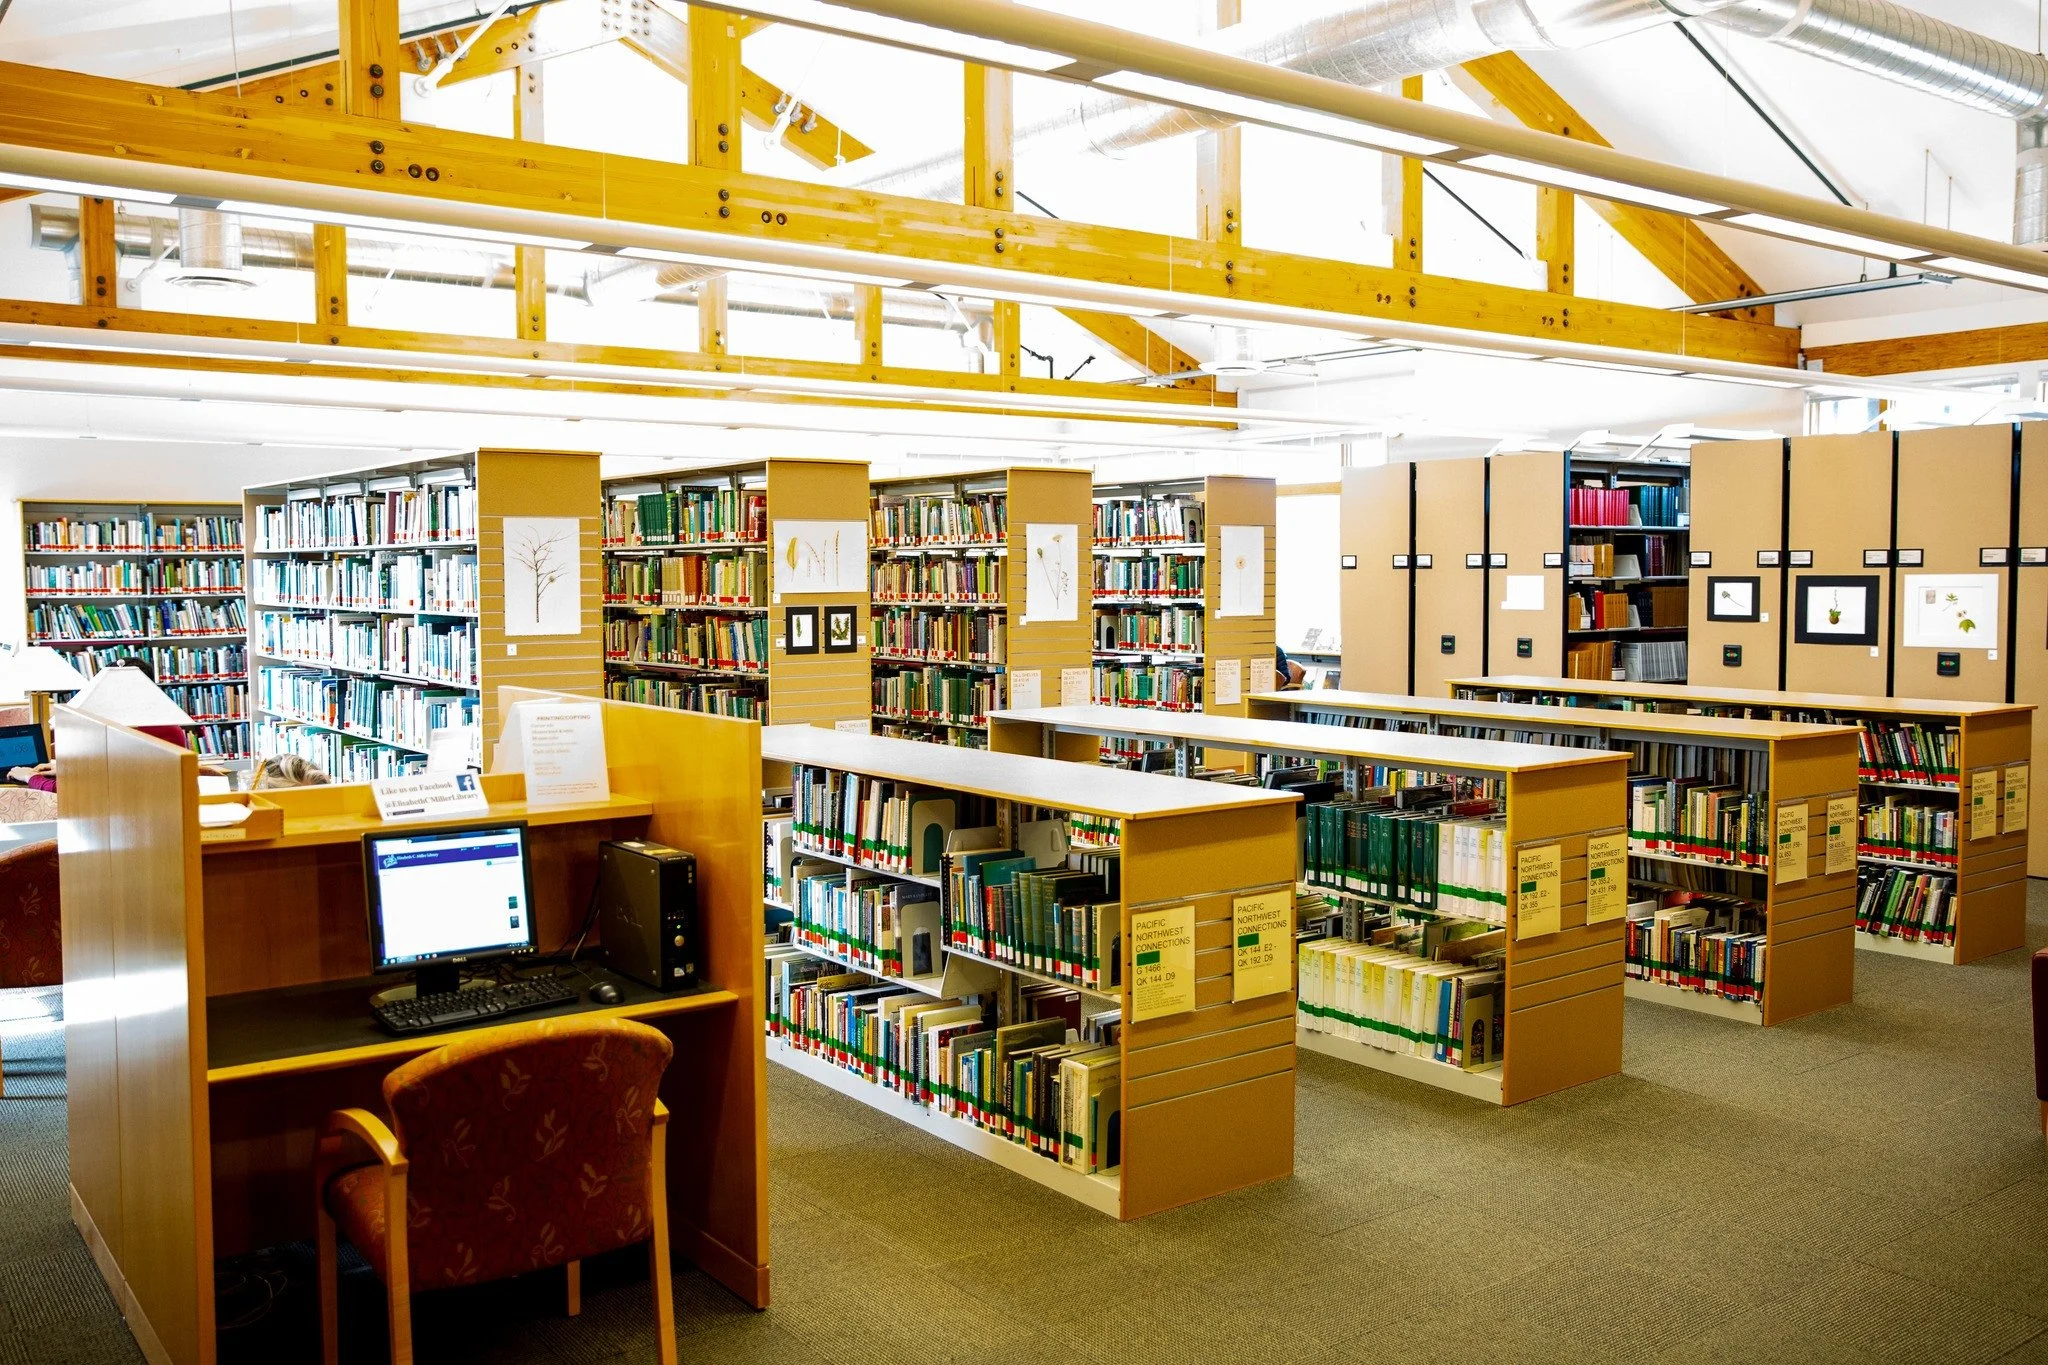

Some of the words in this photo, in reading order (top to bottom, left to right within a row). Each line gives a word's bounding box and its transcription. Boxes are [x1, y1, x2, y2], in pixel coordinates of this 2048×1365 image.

[419, 782, 453, 791] Facebook
[1591, 842, 1609, 851] PACIFIC
[1521, 855, 1541, 864] PACIFIC
[1591, 849, 1620, 860] NORTHWEST
[1521, 862, 1553, 873] NORTHWEST
[1591, 857, 1625, 868] CONNECTIONS
[1520, 870, 1558, 882] CONNECTIONS
[1521, 893, 1528, 901] QK
[1530, 891, 1538, 899] 192
[1237, 903, 1265, 913] PACIFIC
[1530, 901, 1538, 909] 355
[1237, 910, 1281, 924] NORTHWEST
[1136, 919, 1166, 930] PACIFIC
[1237, 920, 1287, 935] CONNECTIONS
[1136, 927, 1184, 941] NORTHWEST
[1135, 937, 1190, 953] CONNECTIONS
[1237, 948, 1248, 957] QK
[1250, 946, 1260, 954] 144
[1237, 958, 1248, 967] QK
[1250, 956, 1260, 965] 192
[1136, 966, 1142, 975] G
[1145, 964, 1161, 973] 1466
[1136, 976, 1147, 987] QK
[1150, 974, 1162, 982] 144
